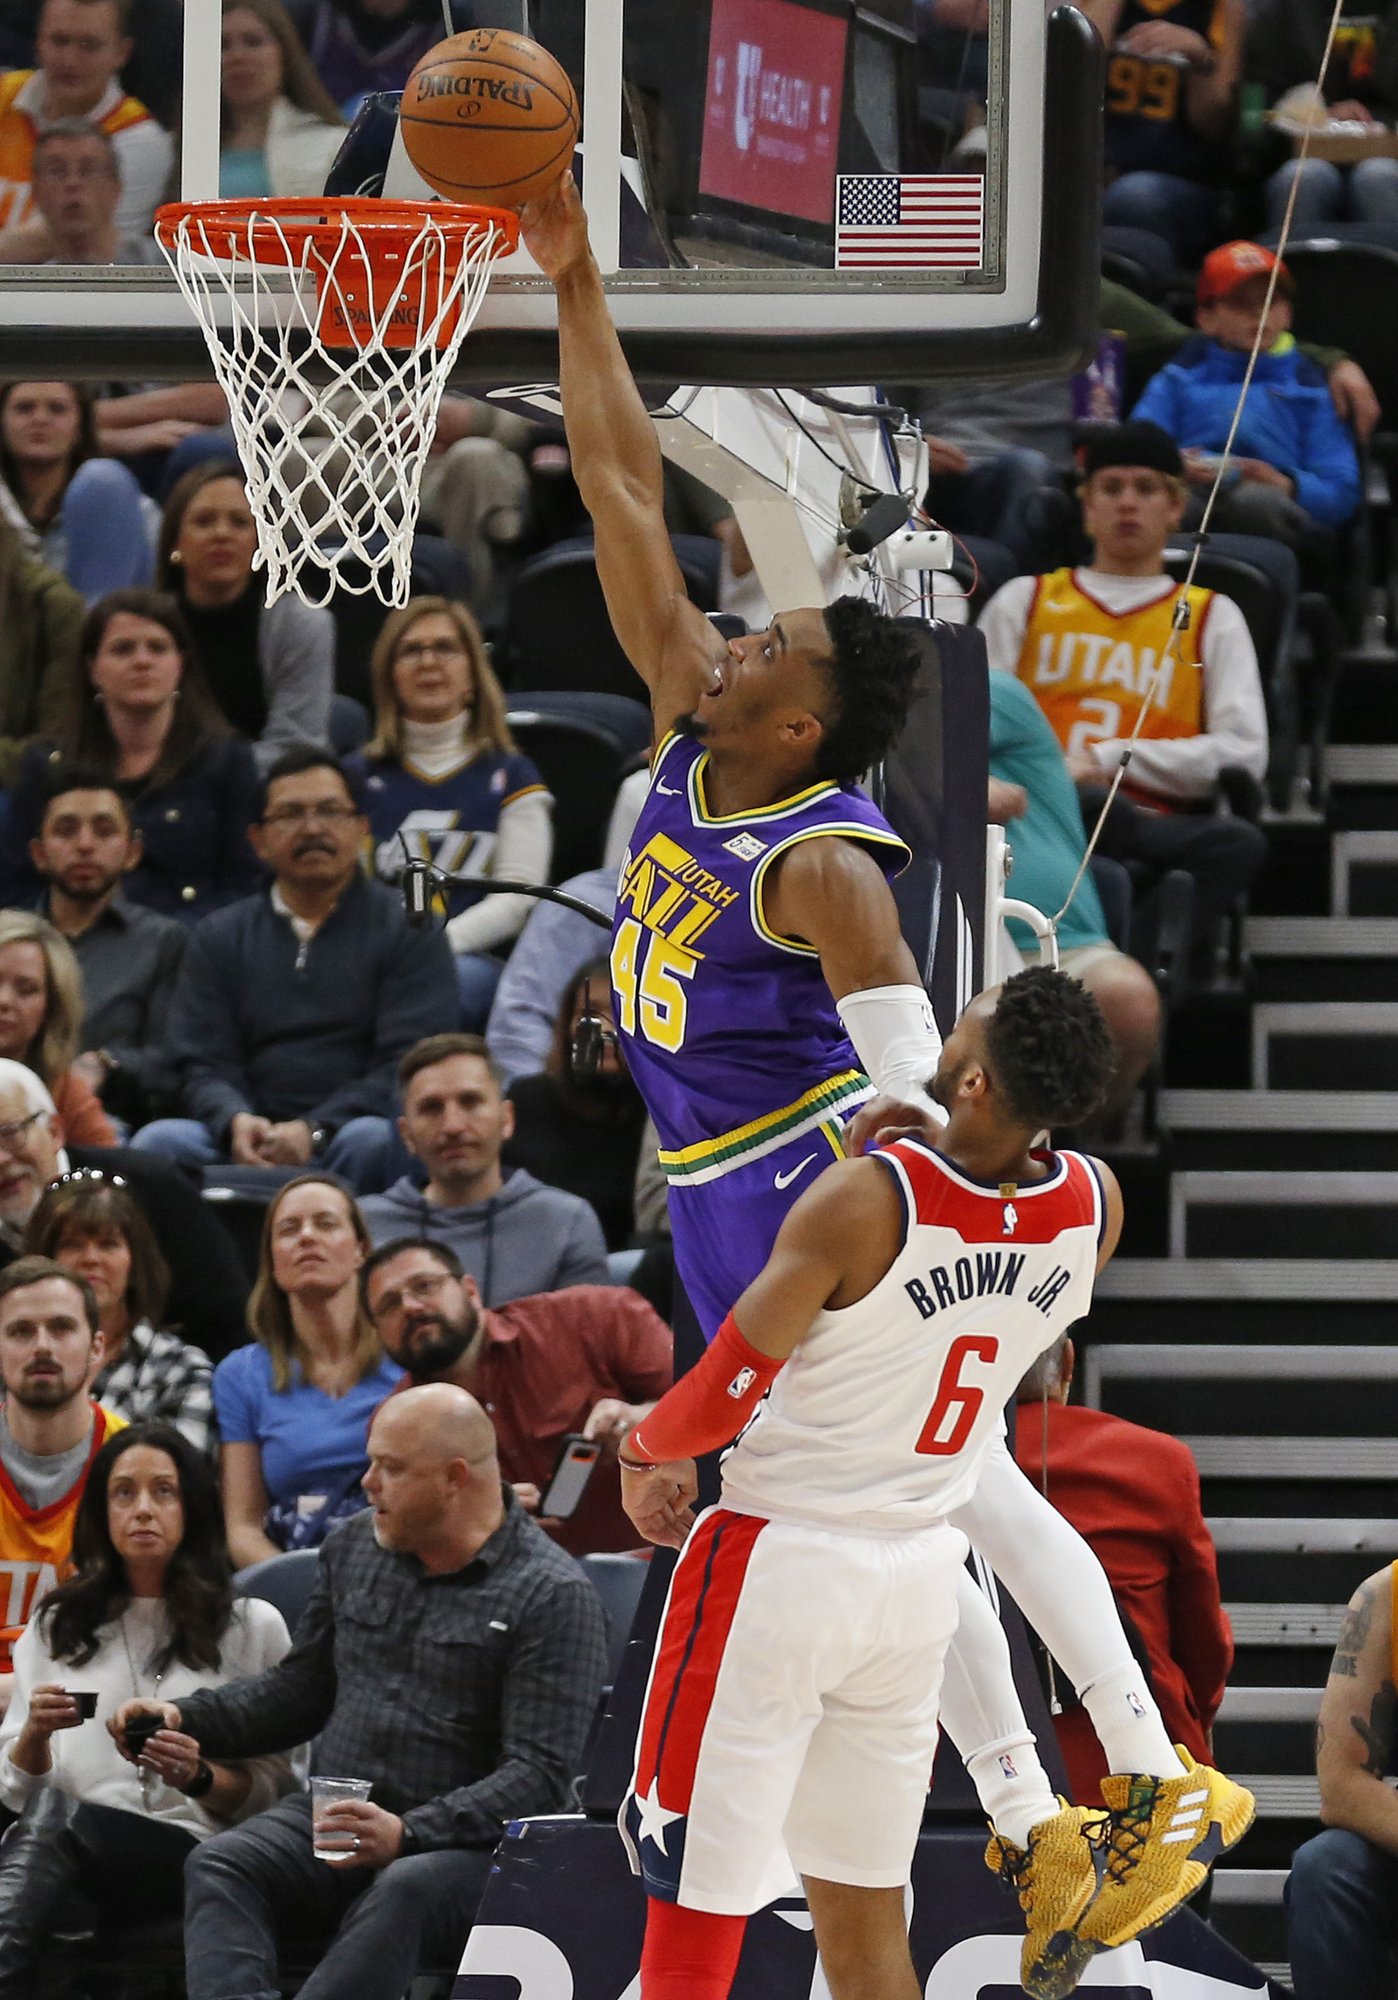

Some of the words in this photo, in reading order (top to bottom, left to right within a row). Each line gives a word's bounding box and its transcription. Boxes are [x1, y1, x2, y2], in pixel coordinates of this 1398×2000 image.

[417, 75, 537, 111] SPALDING
[760, 70, 811, 130] HEALTH
[1108, 57, 1178, 119] 99
[1034, 632, 1175, 710] UTAH
[1067, 697, 1121, 755] 2
[681, 862, 741, 908] UTAH
[609, 916, 698, 1054] 45
[904, 1251, 1026, 1320] BROWN
[1027, 1265, 1071, 1318] JR.
[914, 1335, 999, 1455] 6
